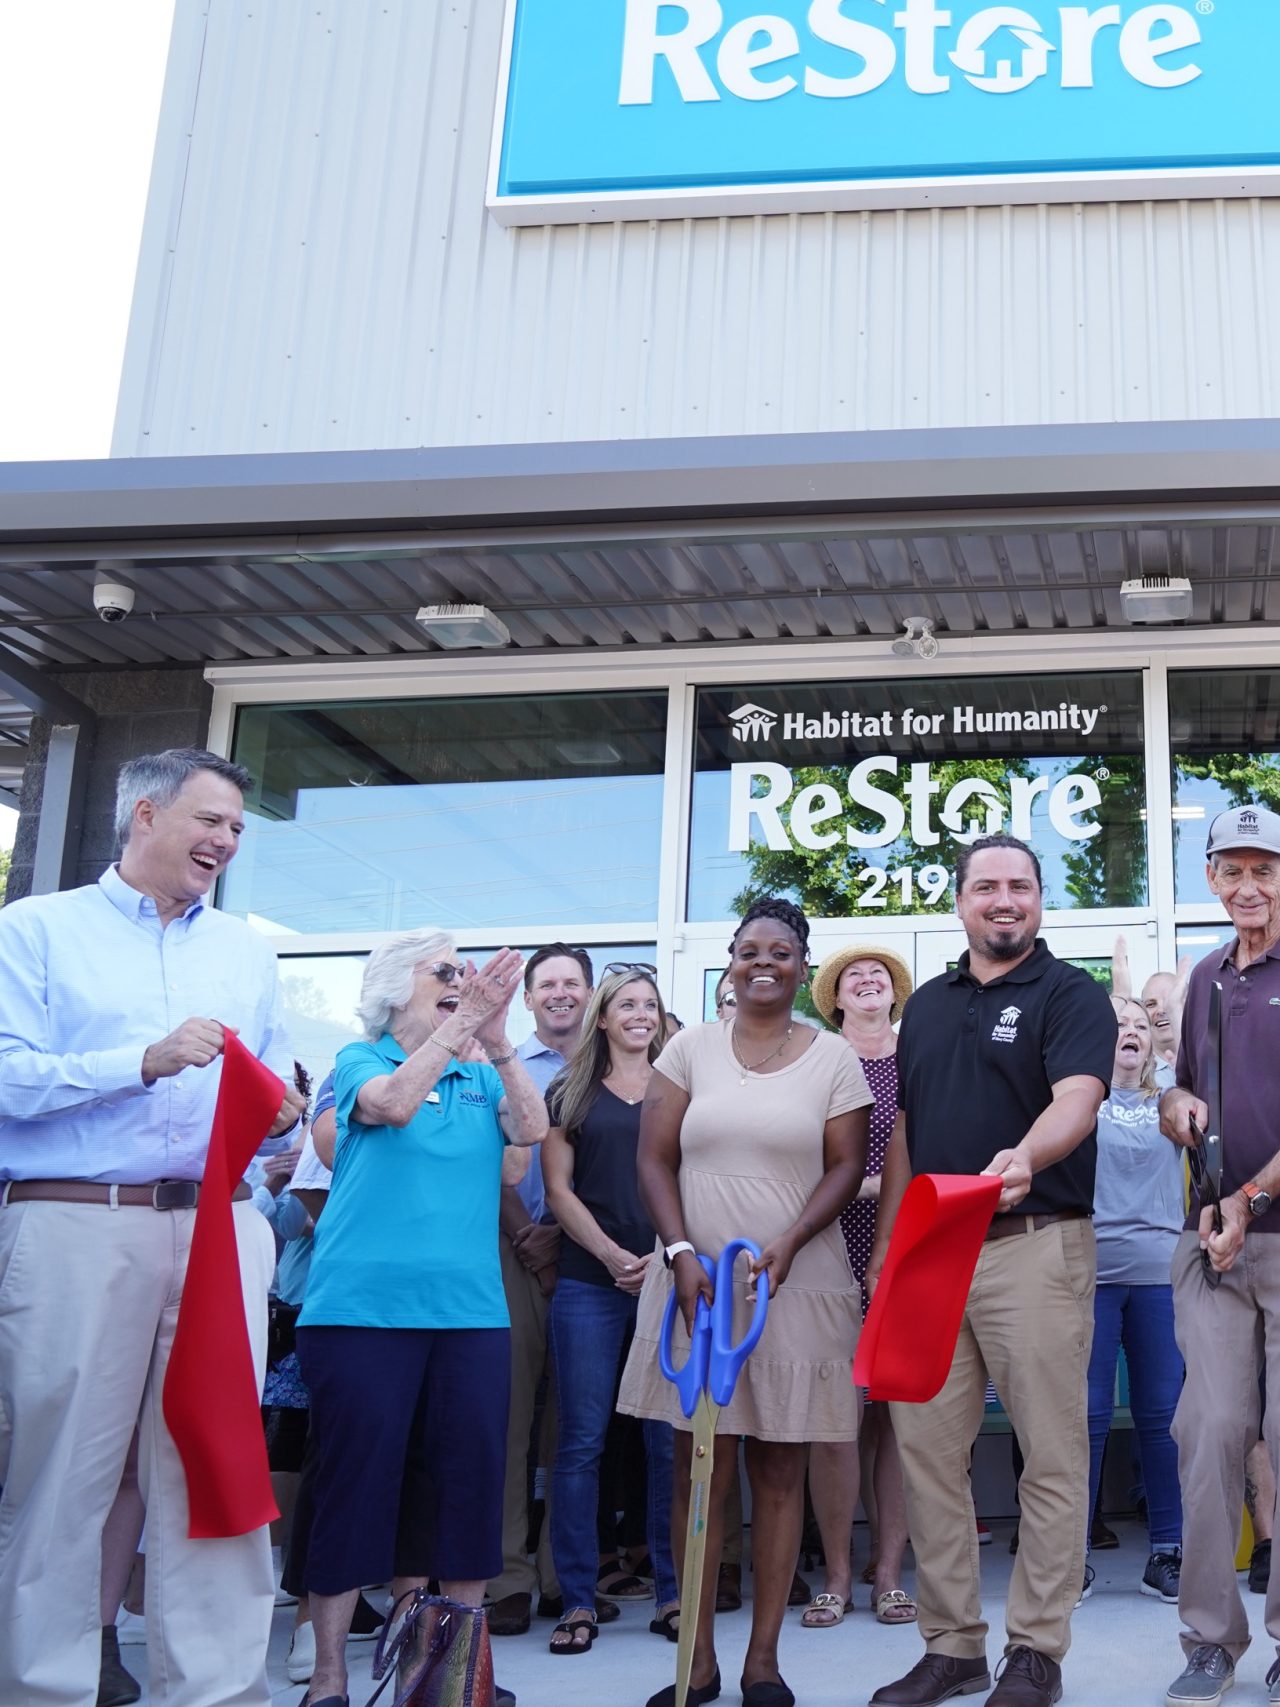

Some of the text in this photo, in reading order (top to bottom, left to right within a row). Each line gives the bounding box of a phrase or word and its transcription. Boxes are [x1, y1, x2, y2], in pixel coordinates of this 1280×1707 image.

[619, 0, 1203, 105] ReStore
[783, 702, 1099, 740] Habitat for Humanity
[728, 755, 1103, 852] ReStore
[853, 863, 957, 907] 219
[993, 1024, 1018, 1035] Habitat
